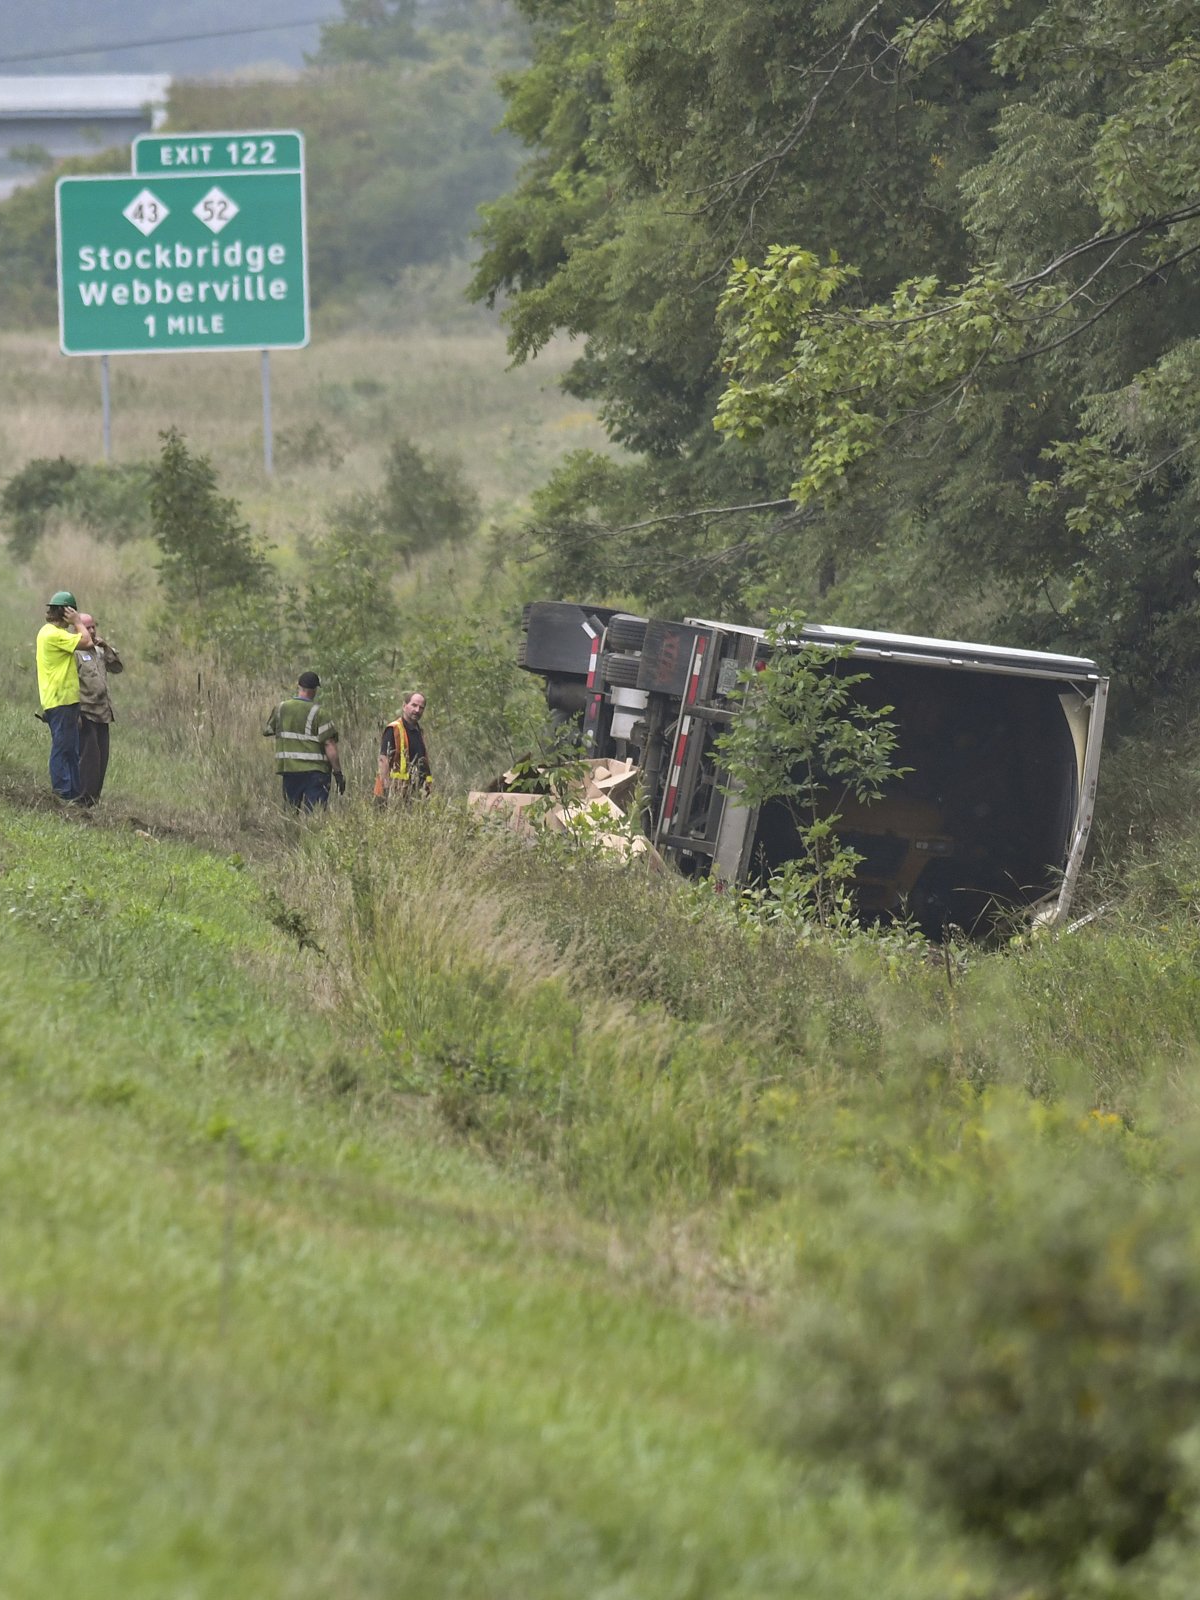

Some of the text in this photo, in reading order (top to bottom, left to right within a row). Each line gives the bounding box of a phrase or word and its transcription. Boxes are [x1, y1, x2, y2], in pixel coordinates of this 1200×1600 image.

[160, 141, 277, 166] EXIT 122
[132, 200, 228, 224] 43 52
[78, 241, 286, 273] Stockbridge
[78, 275, 288, 307] Webberville
[144, 313, 225, 338] 1 MILE
